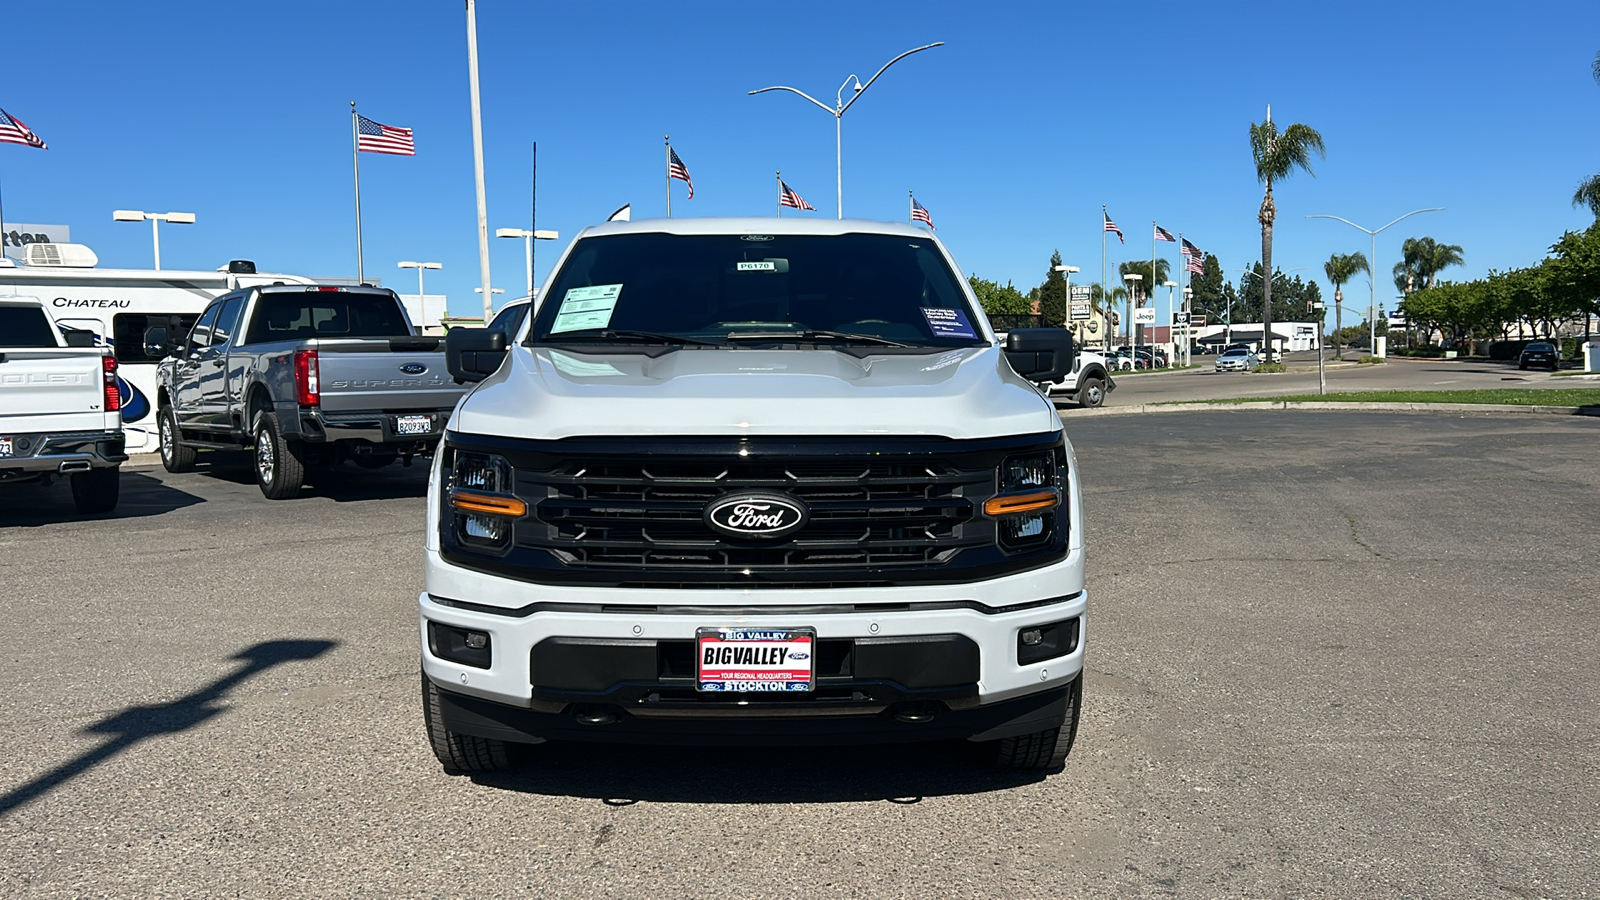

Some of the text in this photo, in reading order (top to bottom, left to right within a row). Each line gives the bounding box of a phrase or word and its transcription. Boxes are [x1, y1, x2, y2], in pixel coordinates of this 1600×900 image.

[1071, 287, 1090, 295] OEM
[52, 297, 131, 308] CHATEAU
[1136, 313, 1154, 321] Jeep
[331, 379, 422, 388] SUPER
[727, 503, 785, 528] Ford
[725, 632, 787, 640] BIG VALLEY
[703, 647, 789, 665] BIGVALLEY
[724, 681, 787, 691] STOCKTON
